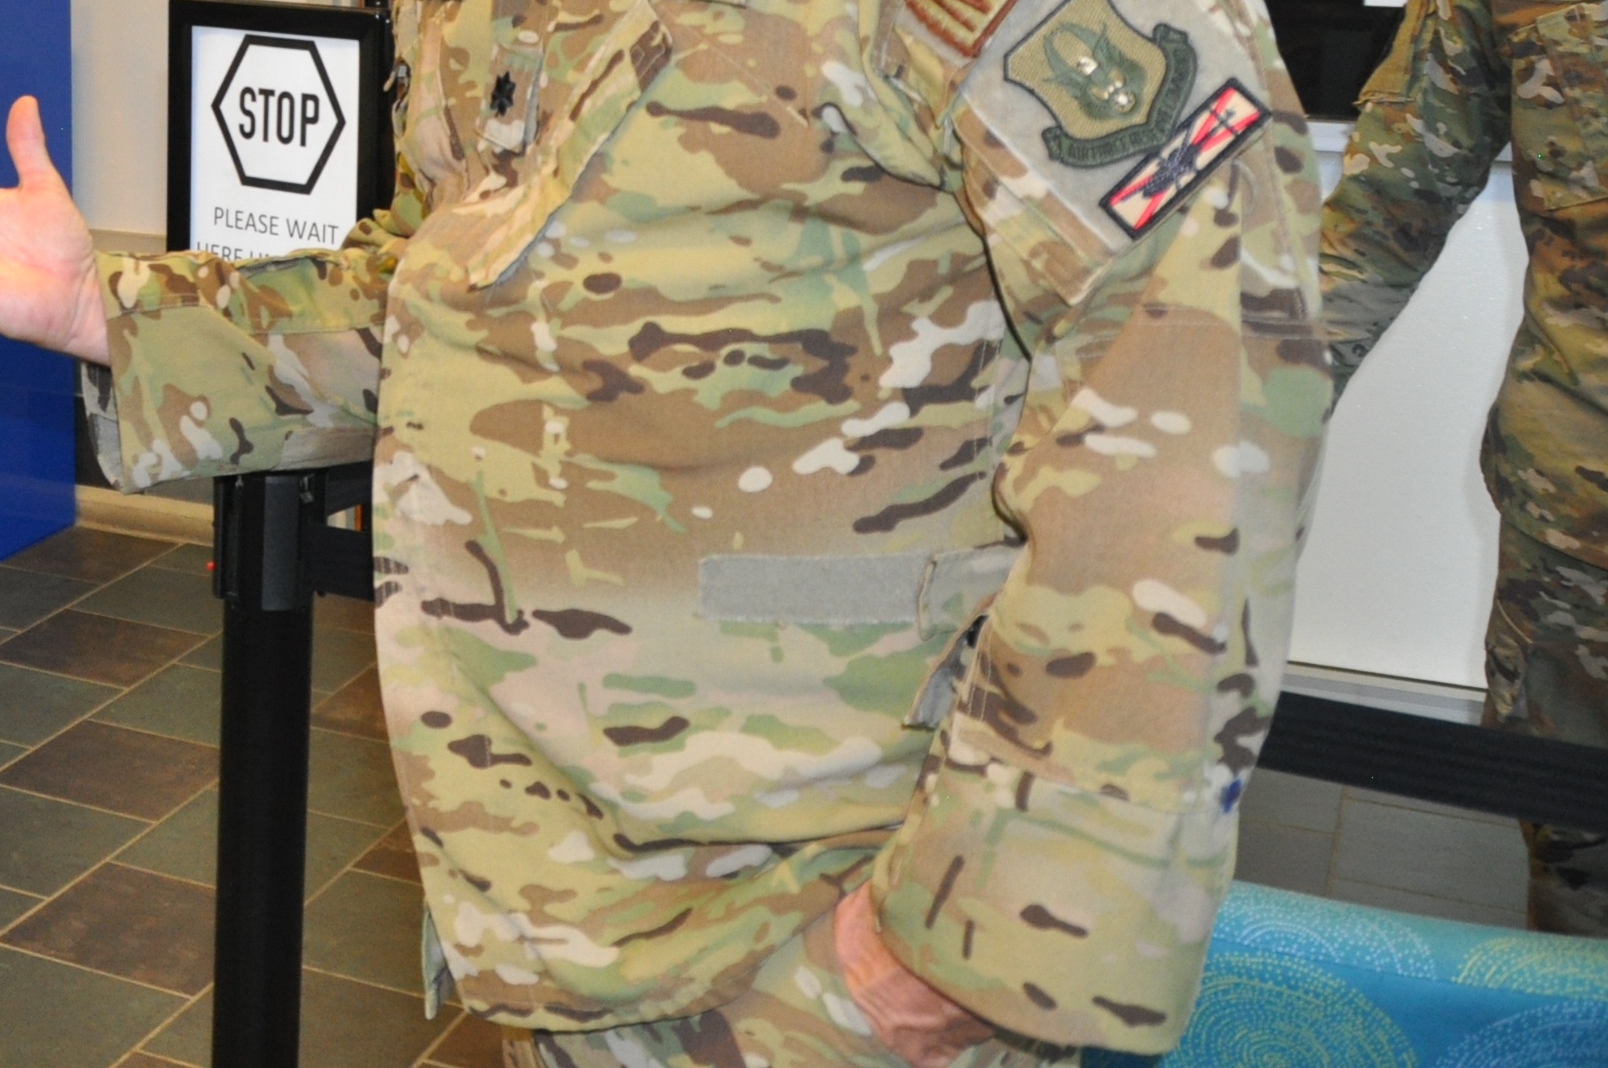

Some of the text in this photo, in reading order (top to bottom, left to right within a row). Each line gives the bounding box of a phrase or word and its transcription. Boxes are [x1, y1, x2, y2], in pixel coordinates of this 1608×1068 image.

[239, 86, 320, 147] STOP
[214, 206, 339, 245] PLEASE WAIT
